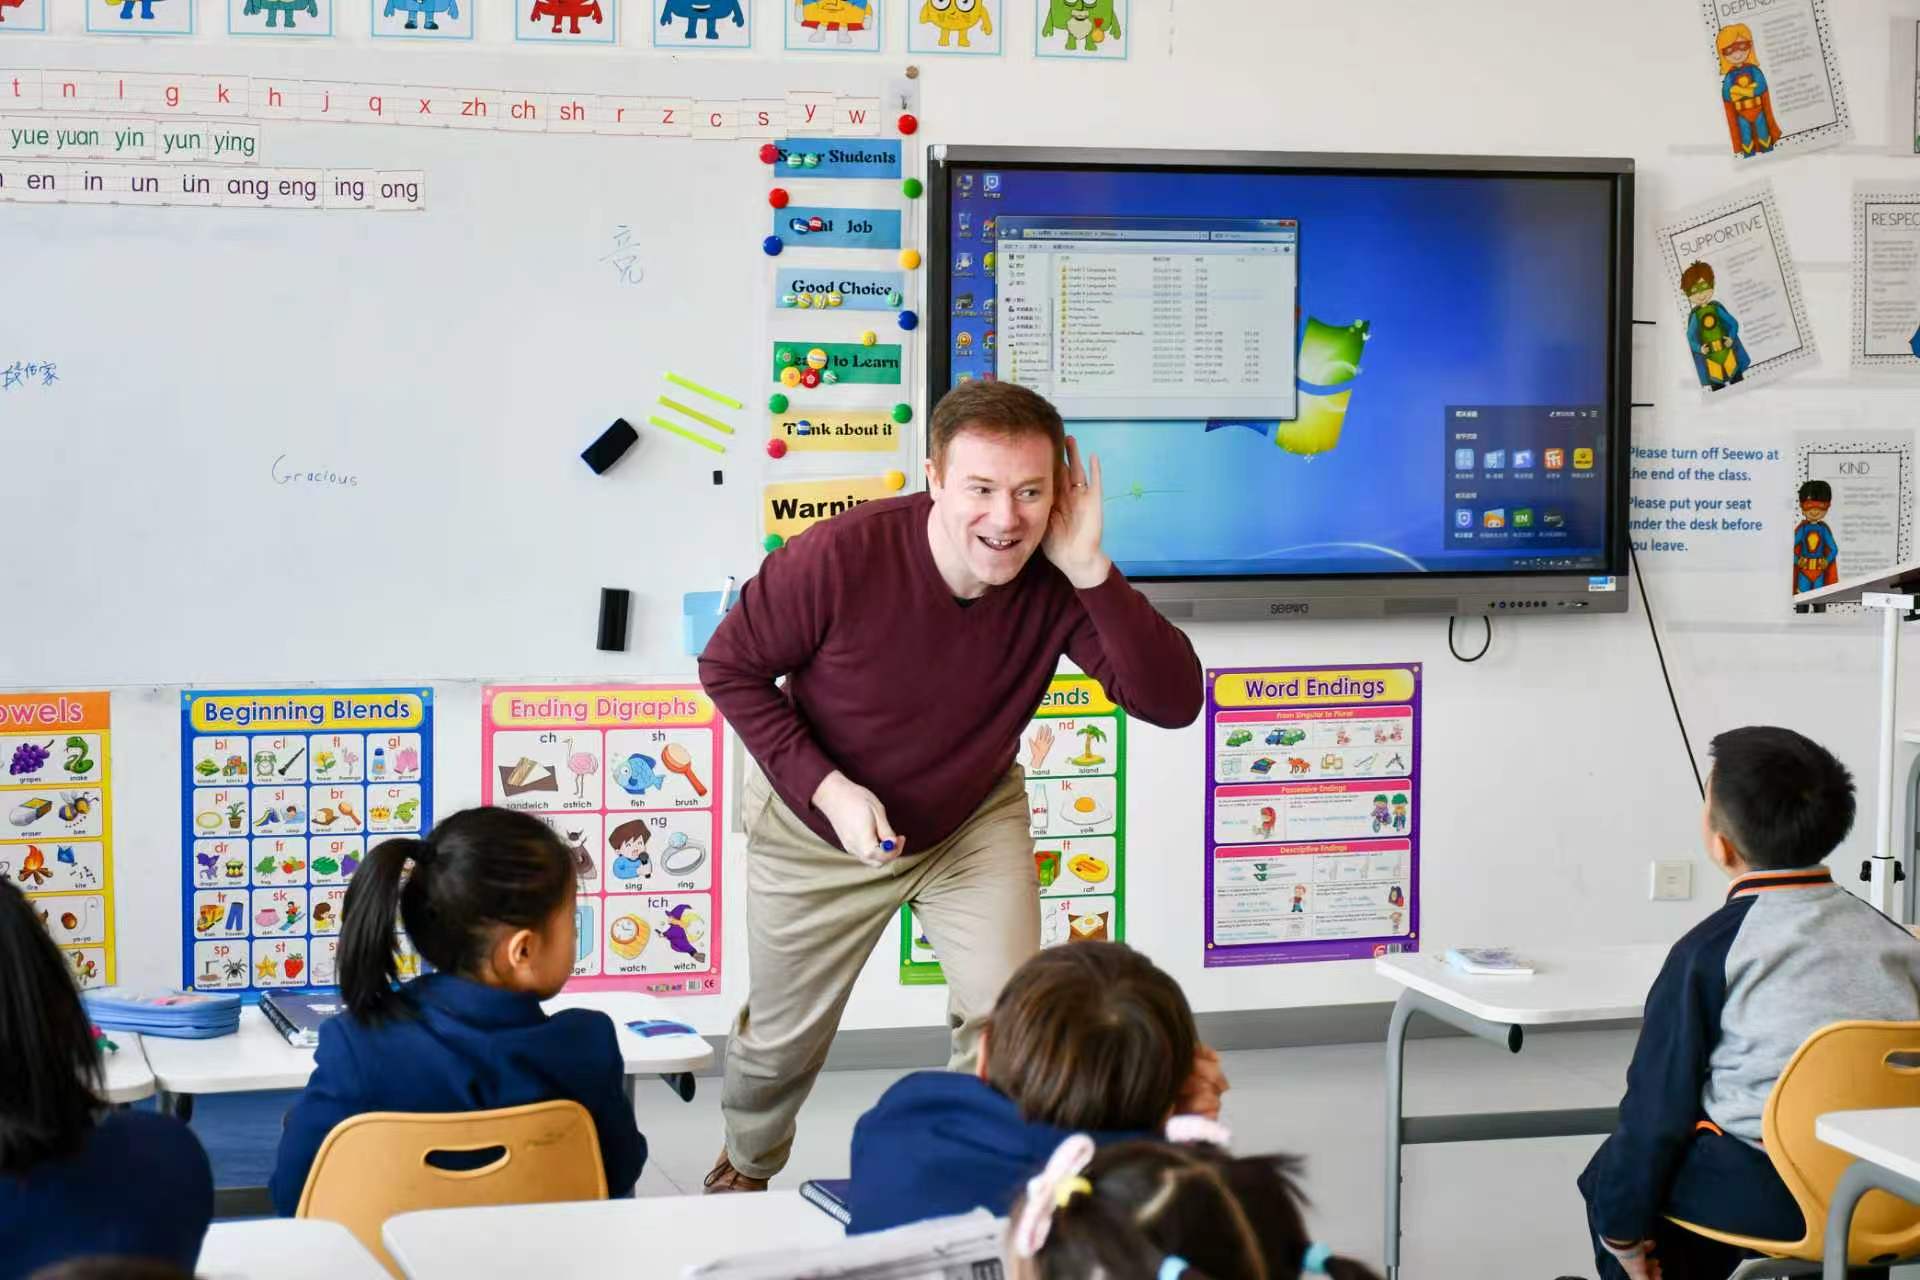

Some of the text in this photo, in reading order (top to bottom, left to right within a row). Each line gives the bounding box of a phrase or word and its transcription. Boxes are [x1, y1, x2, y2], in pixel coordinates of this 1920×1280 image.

[13, 79, 866, 127] t n l g k h j q x zh ch sh r z c s y w
[11, 127, 255, 154] yue yuan yin yun ying
[829, 149, 896, 164] Students
[27, 171, 418, 203] en in un ün ang eng ing ong
[846, 220, 872, 233] Job
[1680, 214, 1763, 256] SUPPORTIVE
[792, 280, 892, 296] Good Choice
[834, 355, 849, 368] to
[852, 354, 899, 368] Learn
[783, 422, 892, 435] Tnk about it
[1671, 448, 1697, 459] turn
[1702, 447, 1720, 459] off
[1722, 448, 1763, 460] Seewo
[1767, 449, 1779, 460] at
[271, 454, 358, 486] Gracious
[1651, 468, 1674, 480] end
[1678, 468, 1692, 480] of
[1694, 468, 1715, 481] the
[1718, 469, 1752, 481] class.
[1839, 462, 1870, 475] KIND
[772, 495, 869, 519] Warni
[1670, 498, 1691, 511] put
[1695, 499, 1722, 511] your
[1725, 498, 1752, 510] seat
[1666, 517, 1686, 530] the
[1690, 518, 1718, 530] desk
[1721, 518, 1763, 531] before
[1631, 538, 1688, 552] ou leave.
[1245, 677, 1385, 699] Word Endings
[205, 700, 410, 725] Beginning Blends
[511, 697, 697, 721] Ending Digraphs
[1059, 719, 1075, 730] nd
[273, 736, 286, 749] cl
[388, 736, 401, 750] gl
[540, 732, 557, 744] ch
[652, 731, 666, 742] sh
[215, 738, 227, 750] bl
[1062, 780, 1072, 791] lk
[215, 790, 227, 805] pl
[275, 789, 285, 801] sl
[330, 788, 344, 800] br
[507, 800, 549, 809] sandwich
[563, 800, 592, 808] ostrich
[630, 799, 645, 807] fish
[675, 798, 698, 806] brush
[650, 817, 667, 828] ng
[215, 842, 228, 854] dr
[625, 881, 643, 892] sing
[678, 880, 695, 890] ring
[273, 890, 288, 901] sk
[648, 896, 669, 909] tch
[1060, 901, 1071, 911] st
[214, 945, 230, 957] sp
[275, 942, 286, 953] st
[619, 964, 647, 973] watch
[673, 962, 697, 971] witch
